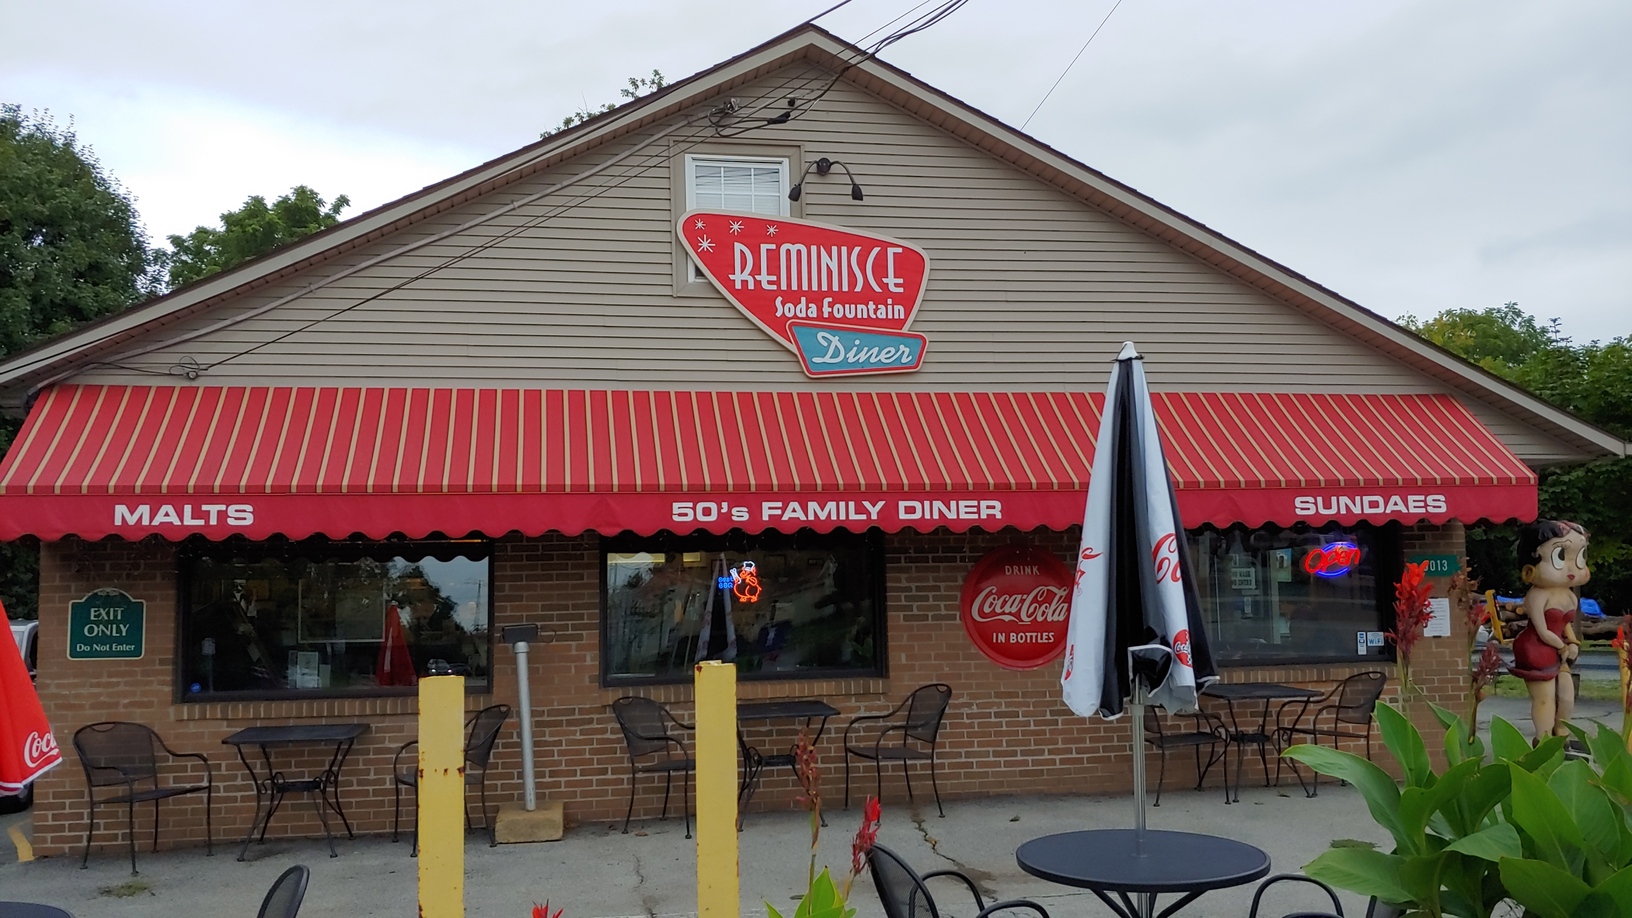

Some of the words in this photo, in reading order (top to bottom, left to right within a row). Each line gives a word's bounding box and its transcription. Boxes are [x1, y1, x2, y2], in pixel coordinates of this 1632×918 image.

[728, 241, 904, 293] REMINISCE
[775, 295, 817, 318] Soda
[822, 297, 905, 319] Fountain
[811, 331, 913, 364] Diner
[114, 504, 254, 526] MALTS
[672, 501, 749, 522] 50's
[762, 501, 886, 521] FAMILY
[898, 500, 1002, 520] DINER
[1294, 494, 1447, 516] SUNDAES
[1004, 564, 1041, 576] DRINK
[90, 607, 125, 621] EXIT
[971, 585, 1070, 625] Coca-Cola
[83, 623, 130, 637] ONLY
[992, 632, 1003, 644] IN
[1010, 632, 1055, 644] BOTTLES
[76, 643, 91, 652] Do
[93, 643, 110, 652] Not
[112, 643, 136, 651] Enter
